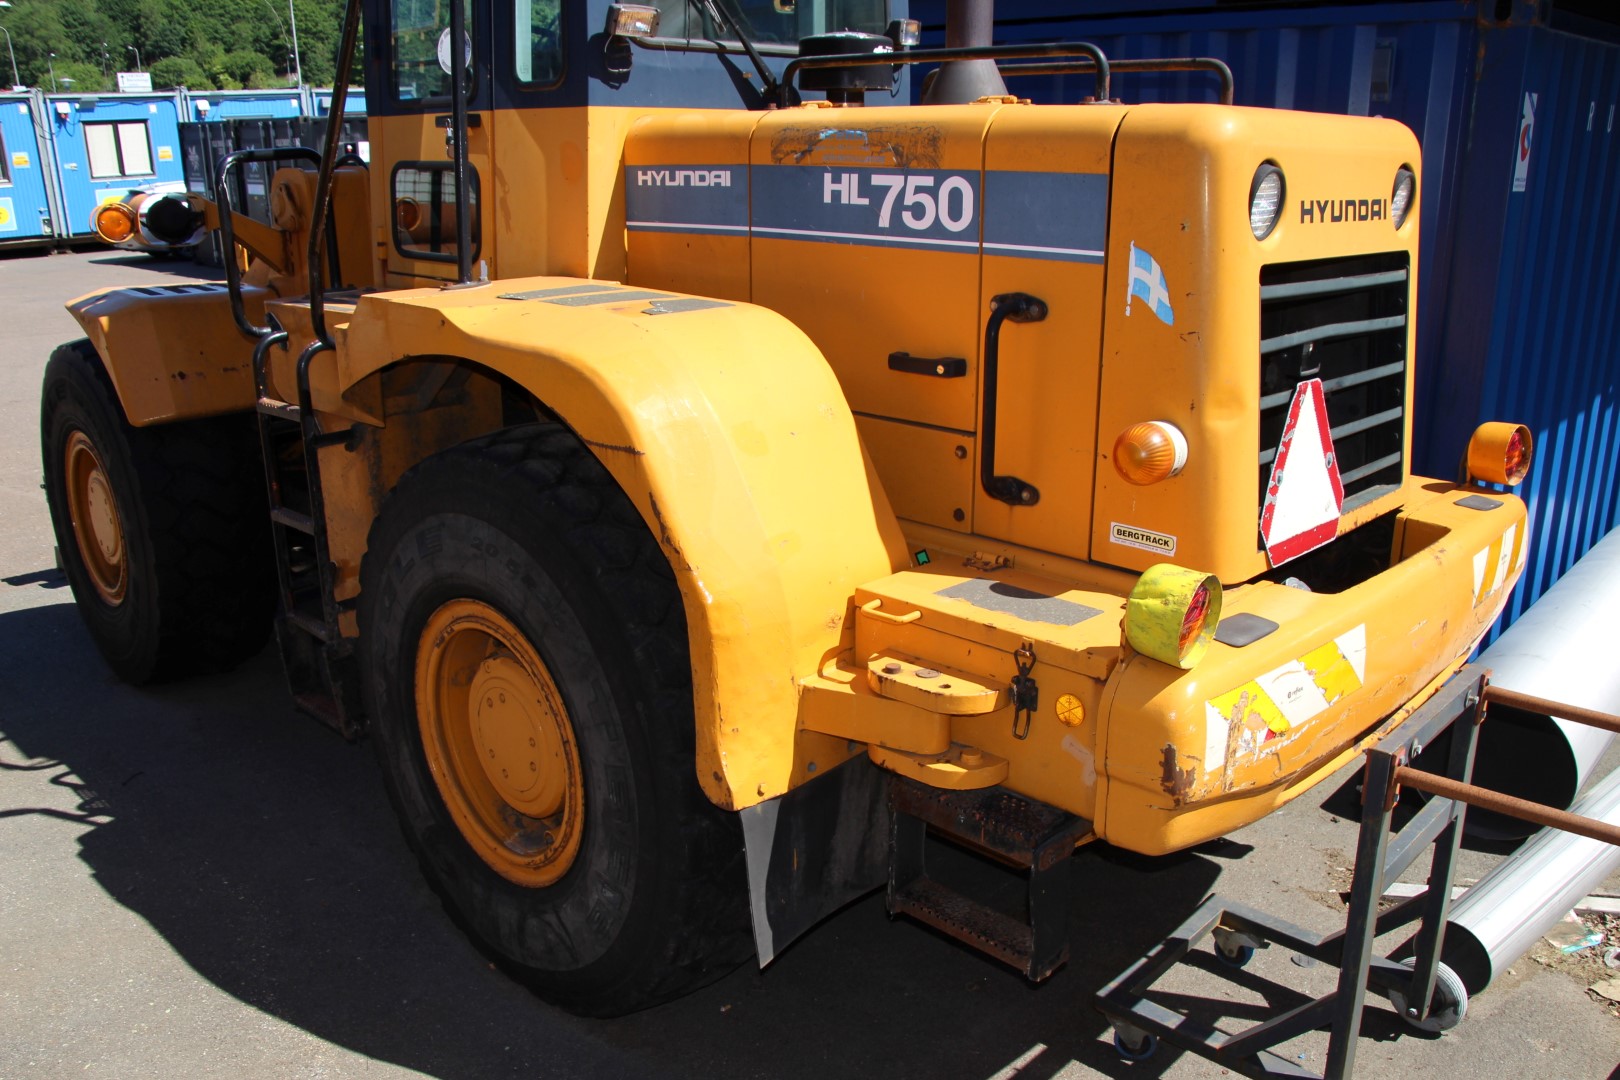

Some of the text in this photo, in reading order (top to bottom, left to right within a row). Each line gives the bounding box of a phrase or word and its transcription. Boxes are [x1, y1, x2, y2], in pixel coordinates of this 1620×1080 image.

[637, 170, 731, 187] HYUNDAI
[1300, 198, 1387, 224] HYUNDAI
[1116, 528, 1170, 548] BERGTRACK
